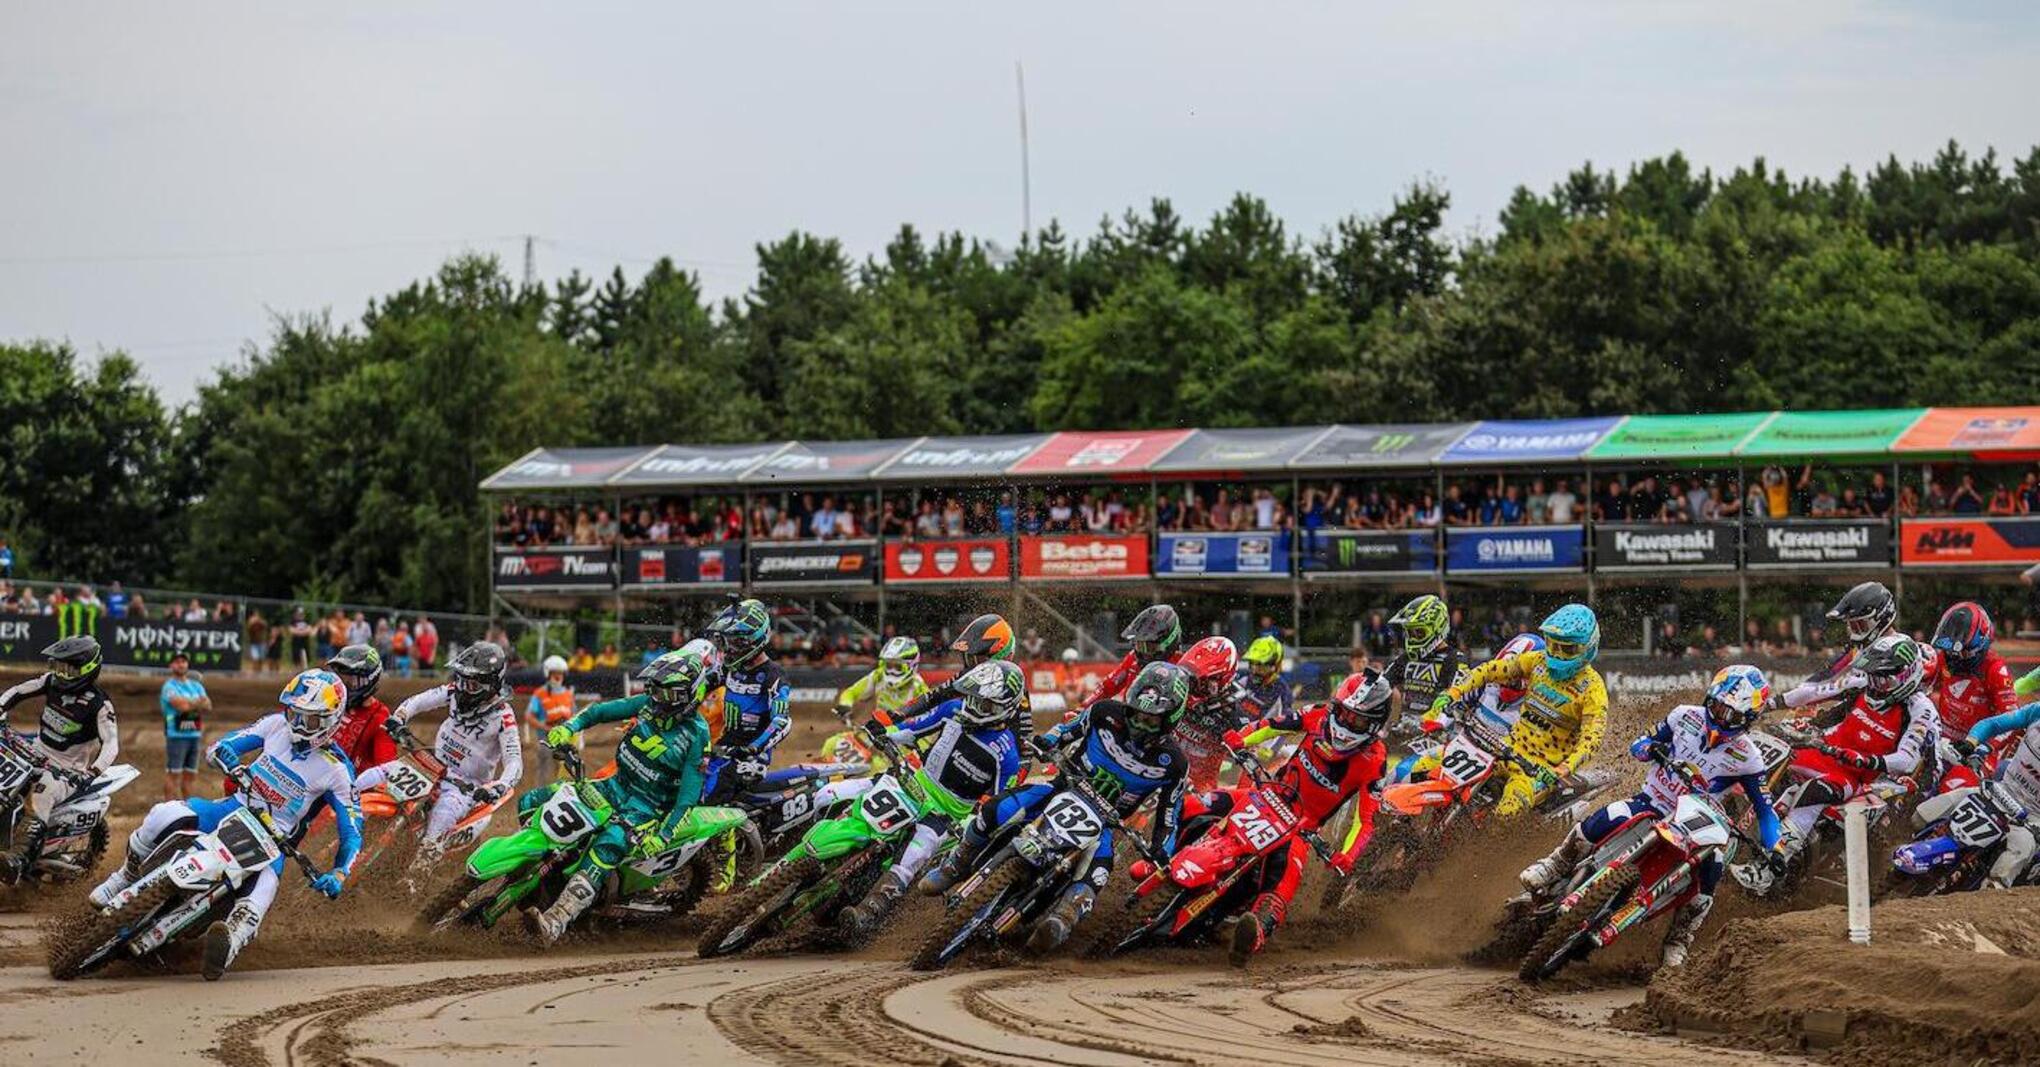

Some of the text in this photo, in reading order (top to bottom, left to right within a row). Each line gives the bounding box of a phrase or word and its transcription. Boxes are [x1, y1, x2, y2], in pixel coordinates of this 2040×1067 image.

[1041, 541, 1128, 560] Beta
[1496, 538, 1554, 559] YAMAHA
[1615, 529, 1715, 551] Kawasaki
[1767, 527, 1869, 548] Kawasaki
[115, 624, 241, 651] MONSTER
[1299, 750, 1340, 793] HONDA
[1442, 749, 1487, 781] 811
[388, 766, 428, 797] 326
[543, 801, 586, 838] 3
[782, 793, 808, 821] 93
[864, 788, 912, 830] 91
[1045, 798, 1101, 846] 132
[1951, 802, 2002, 842] 517
[650, 847, 681, 876] 3
